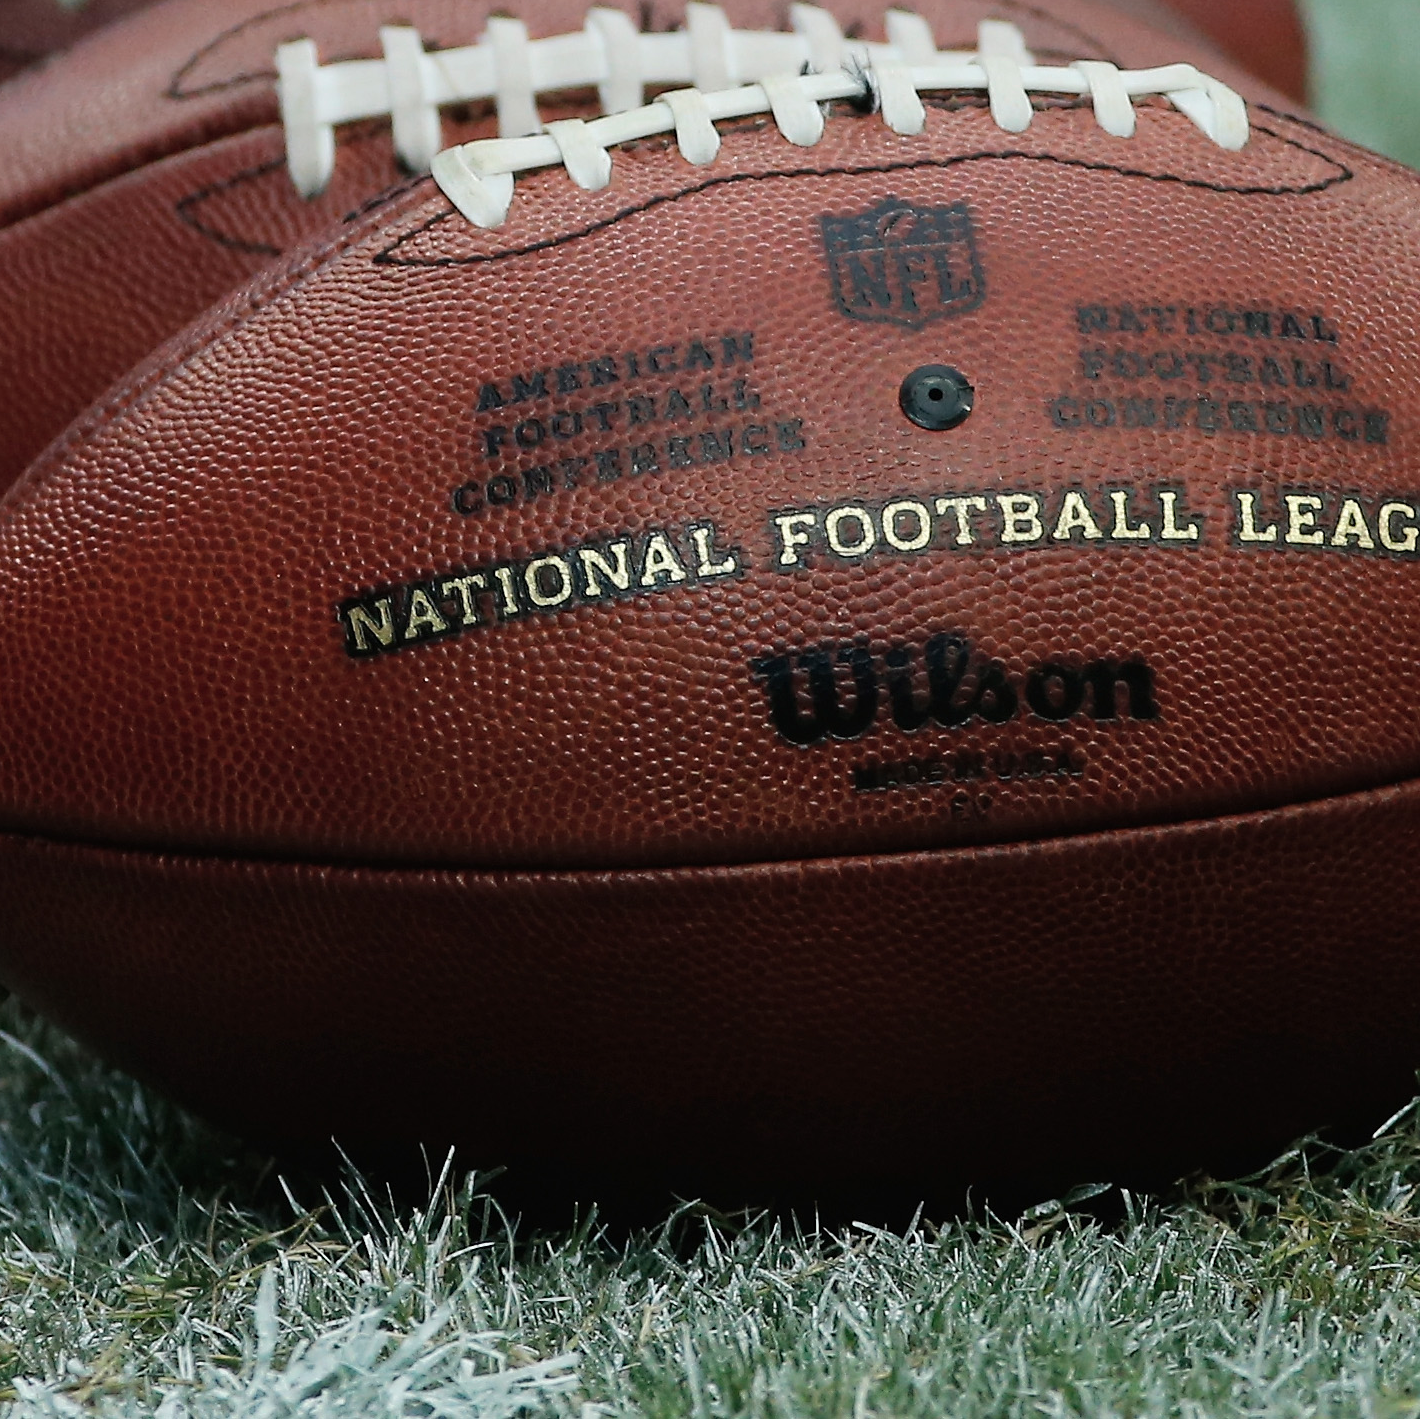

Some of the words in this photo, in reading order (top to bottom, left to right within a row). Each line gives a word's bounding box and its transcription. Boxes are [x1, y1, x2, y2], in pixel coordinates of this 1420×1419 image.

[844, 248, 973, 315] NFL
[1077, 303, 1337, 345] NATIONAL
[476, 331, 755, 412] AMERICAN
[1080, 351, 1349, 391] FOOTBALL
[482, 379, 761, 458] FOOTBALL
[1050, 396, 1391, 444] CONFERENCE
[453, 418, 805, 516] CONFERENCE
[346, 526, 736, 651] NATIONAL
[774, 490, 1199, 565] FOOTBALL
[750, 633, 1159, 746] Wilson
